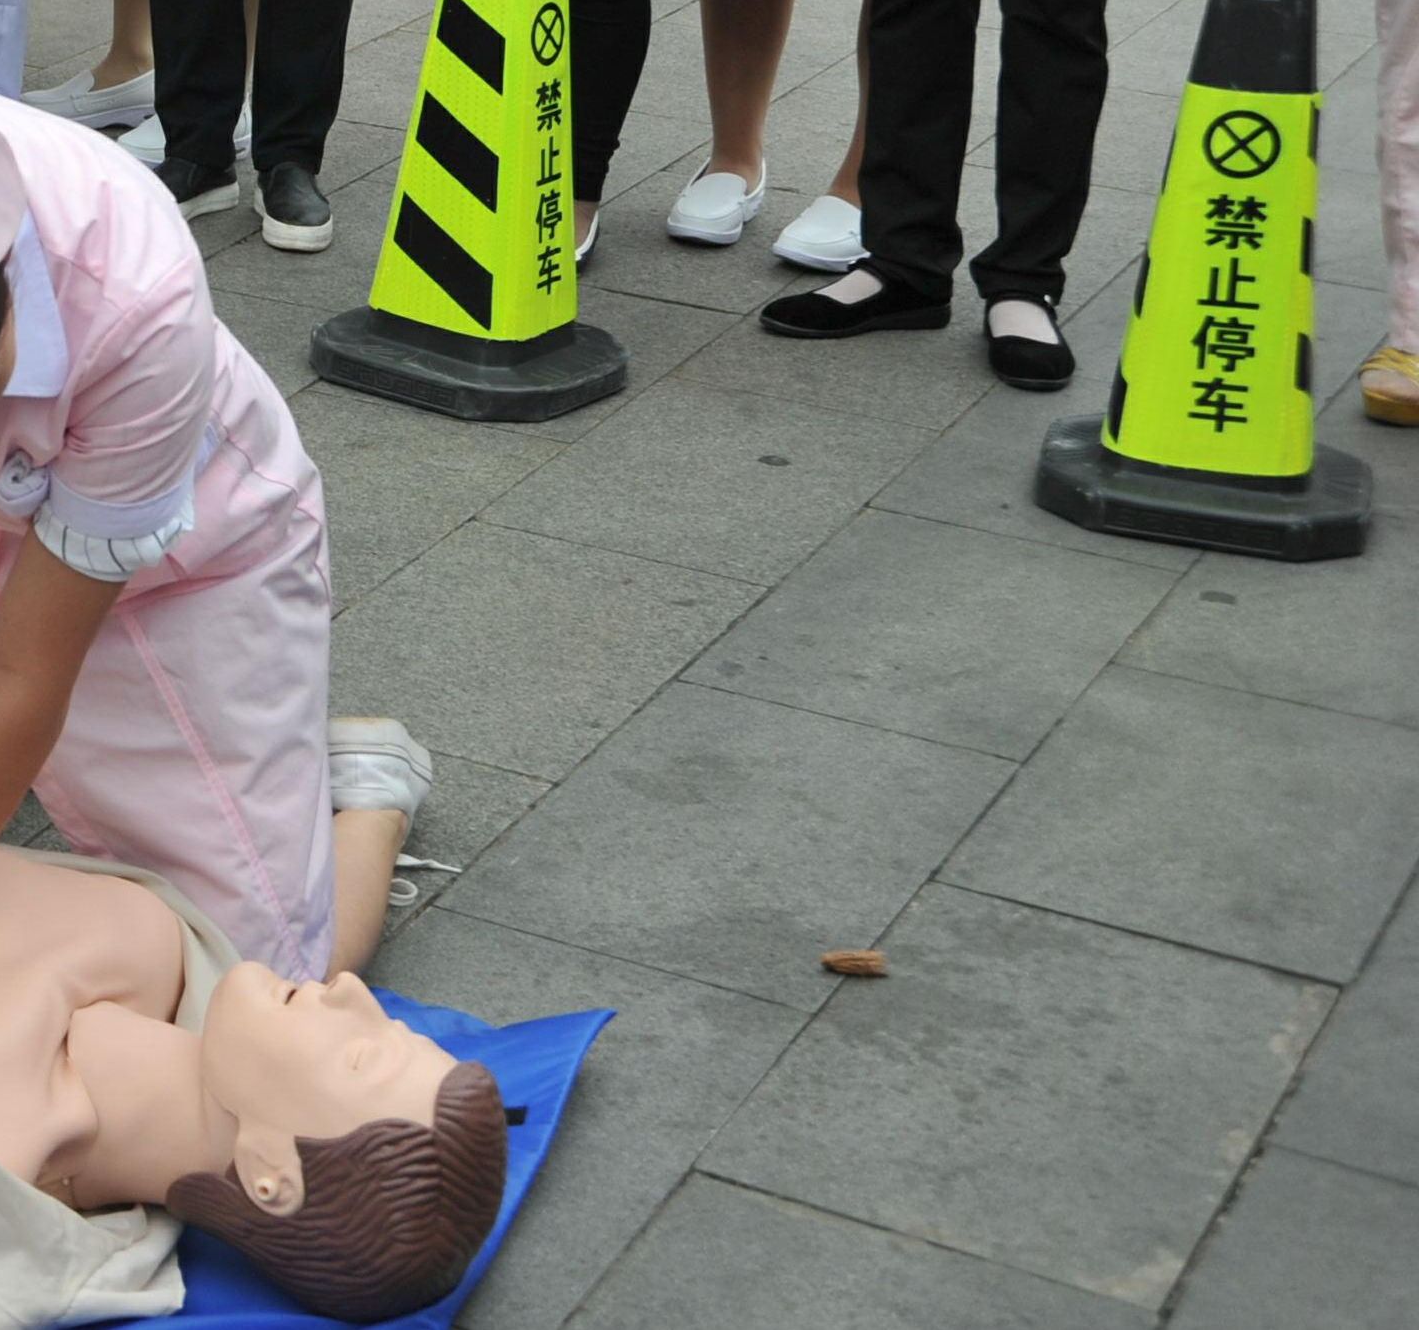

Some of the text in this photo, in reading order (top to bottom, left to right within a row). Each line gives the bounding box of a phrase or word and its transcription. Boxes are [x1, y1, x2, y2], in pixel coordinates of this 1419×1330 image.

[536, 78, 563, 295] 禁止停车
[1187, 194, 1267, 433] 禁止停车
